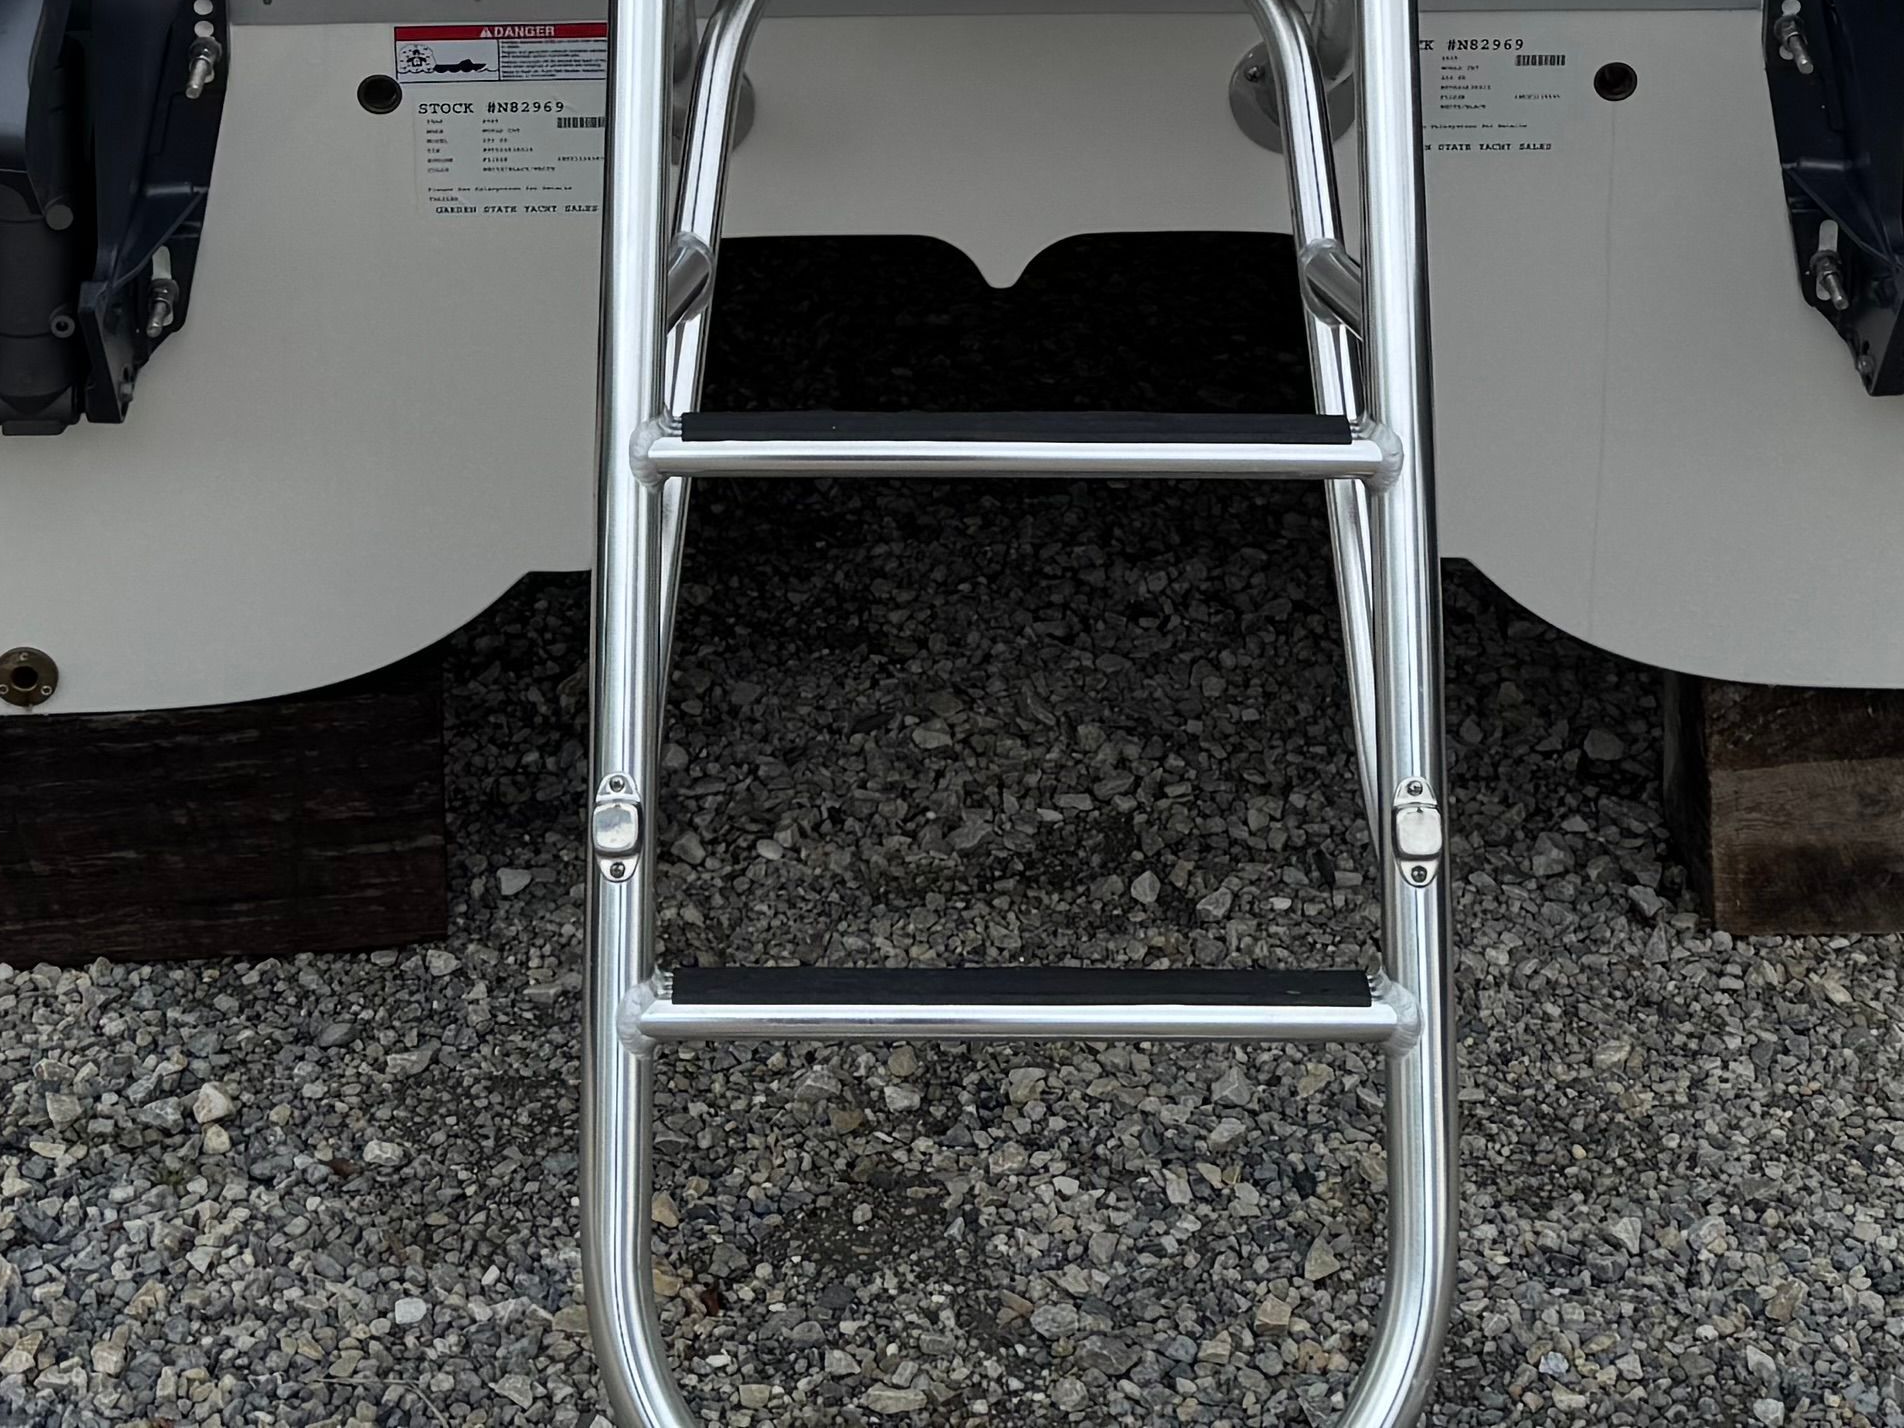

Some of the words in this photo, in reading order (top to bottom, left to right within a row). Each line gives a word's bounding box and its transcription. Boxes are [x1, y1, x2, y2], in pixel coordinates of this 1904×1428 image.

[495, 26, 555, 38] DANGER
[1447, 38, 1524, 51] #N82969
[418, 103, 474, 115] STOCK
[487, 101, 565, 113] #N82969
[436, 206, 477, 214] GARDEN
[483, 205, 517, 213] STATE
[524, 205, 557, 213] YACHT
[565, 204, 599, 212] SALES
